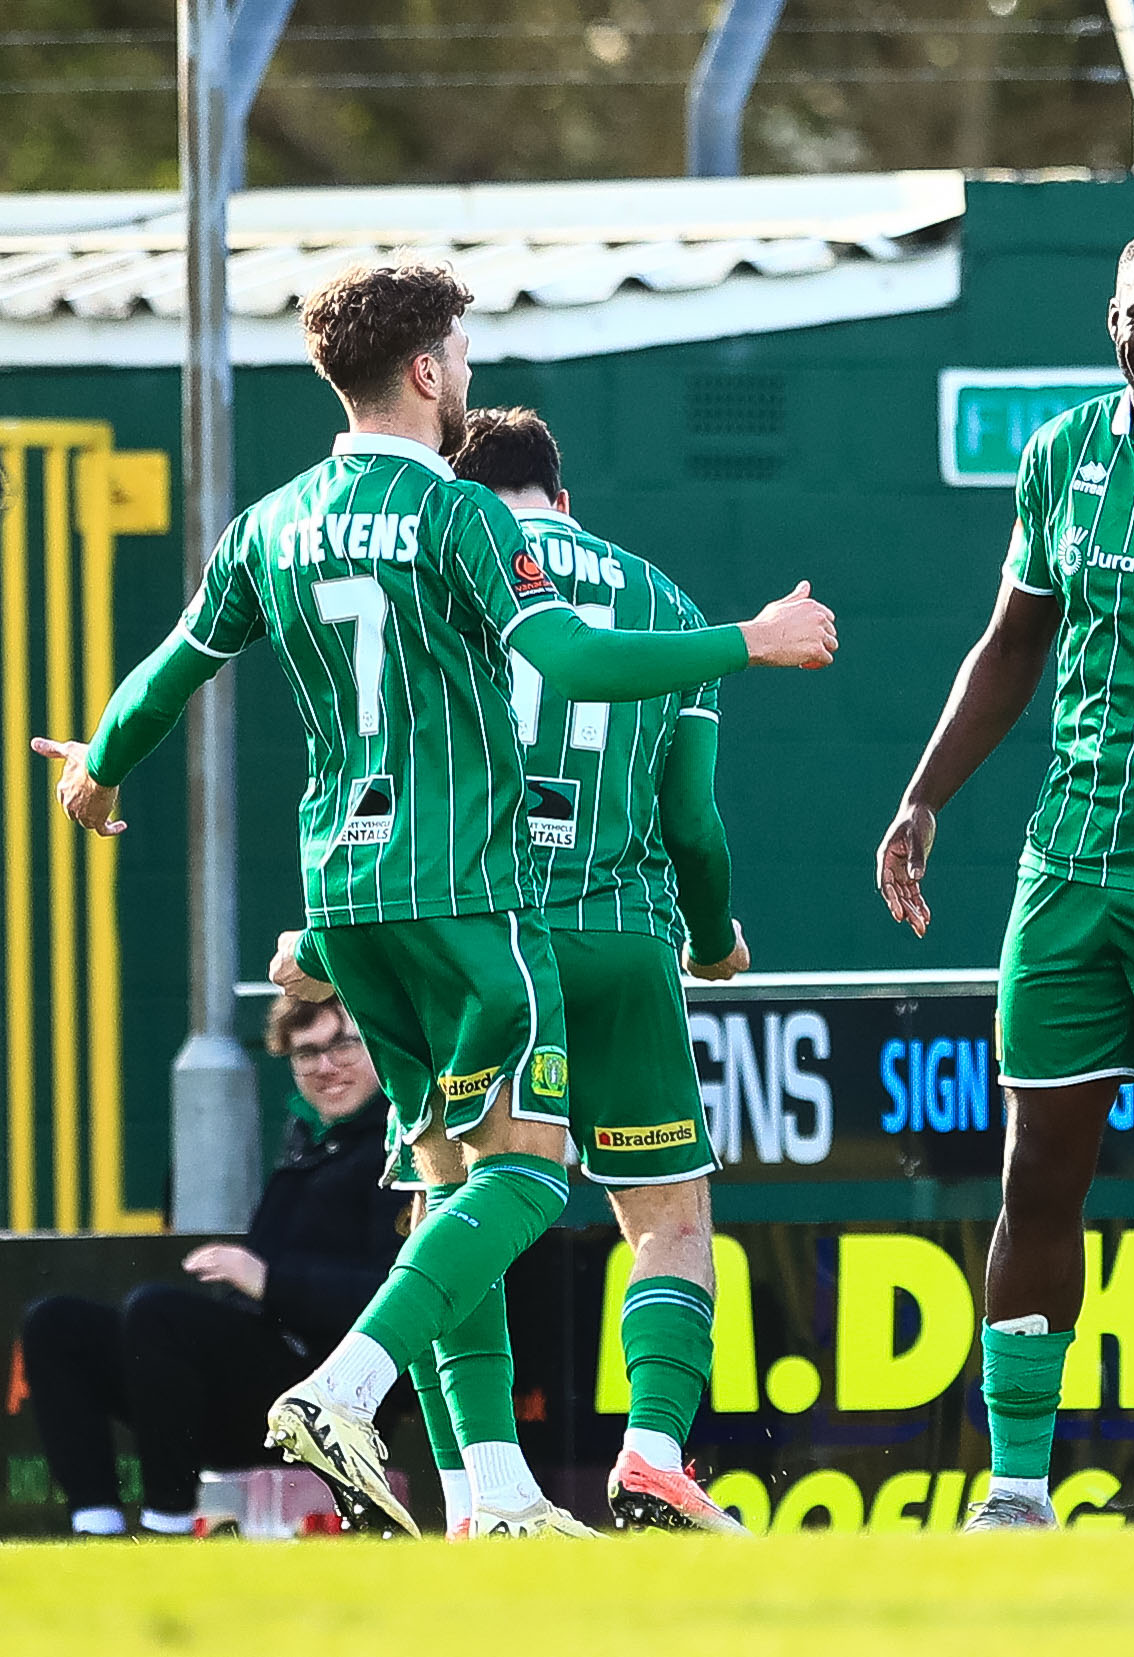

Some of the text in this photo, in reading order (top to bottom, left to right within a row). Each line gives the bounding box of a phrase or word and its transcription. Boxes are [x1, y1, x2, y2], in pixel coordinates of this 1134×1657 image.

[278, 513, 419, 570] STEVENS
[530, 537, 625, 589] UNG
[311, 574, 388, 736] 7
[341, 829, 389, 842] ENTALS
[449, 1072, 491, 1096] dford
[880, 1036, 989, 1134] SIGN
[612, 1126, 693, 1147] Bradfords
